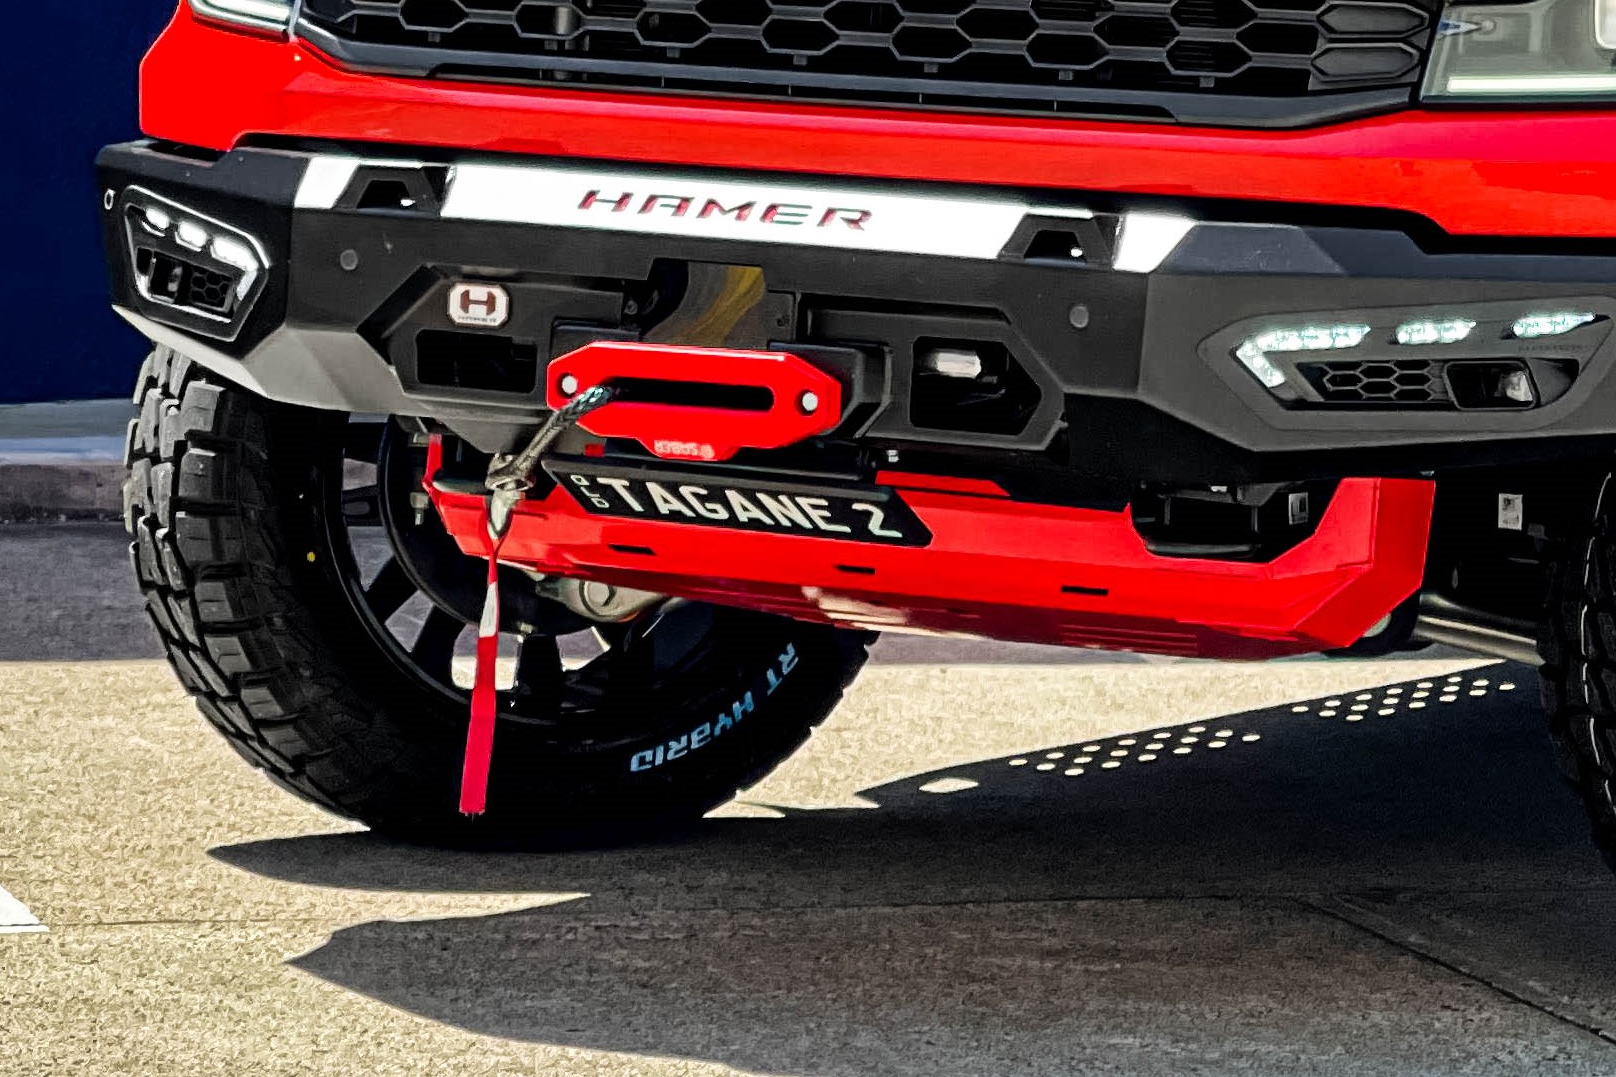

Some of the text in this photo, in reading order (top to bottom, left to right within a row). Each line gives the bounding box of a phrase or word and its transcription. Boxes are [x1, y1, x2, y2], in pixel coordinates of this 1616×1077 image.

[577, 189, 873, 231] HAMER
[570, 474, 610, 509] QLD
[597, 476, 903, 538] TAGANE 2
[629, 642, 799, 772] RT HYBRID
